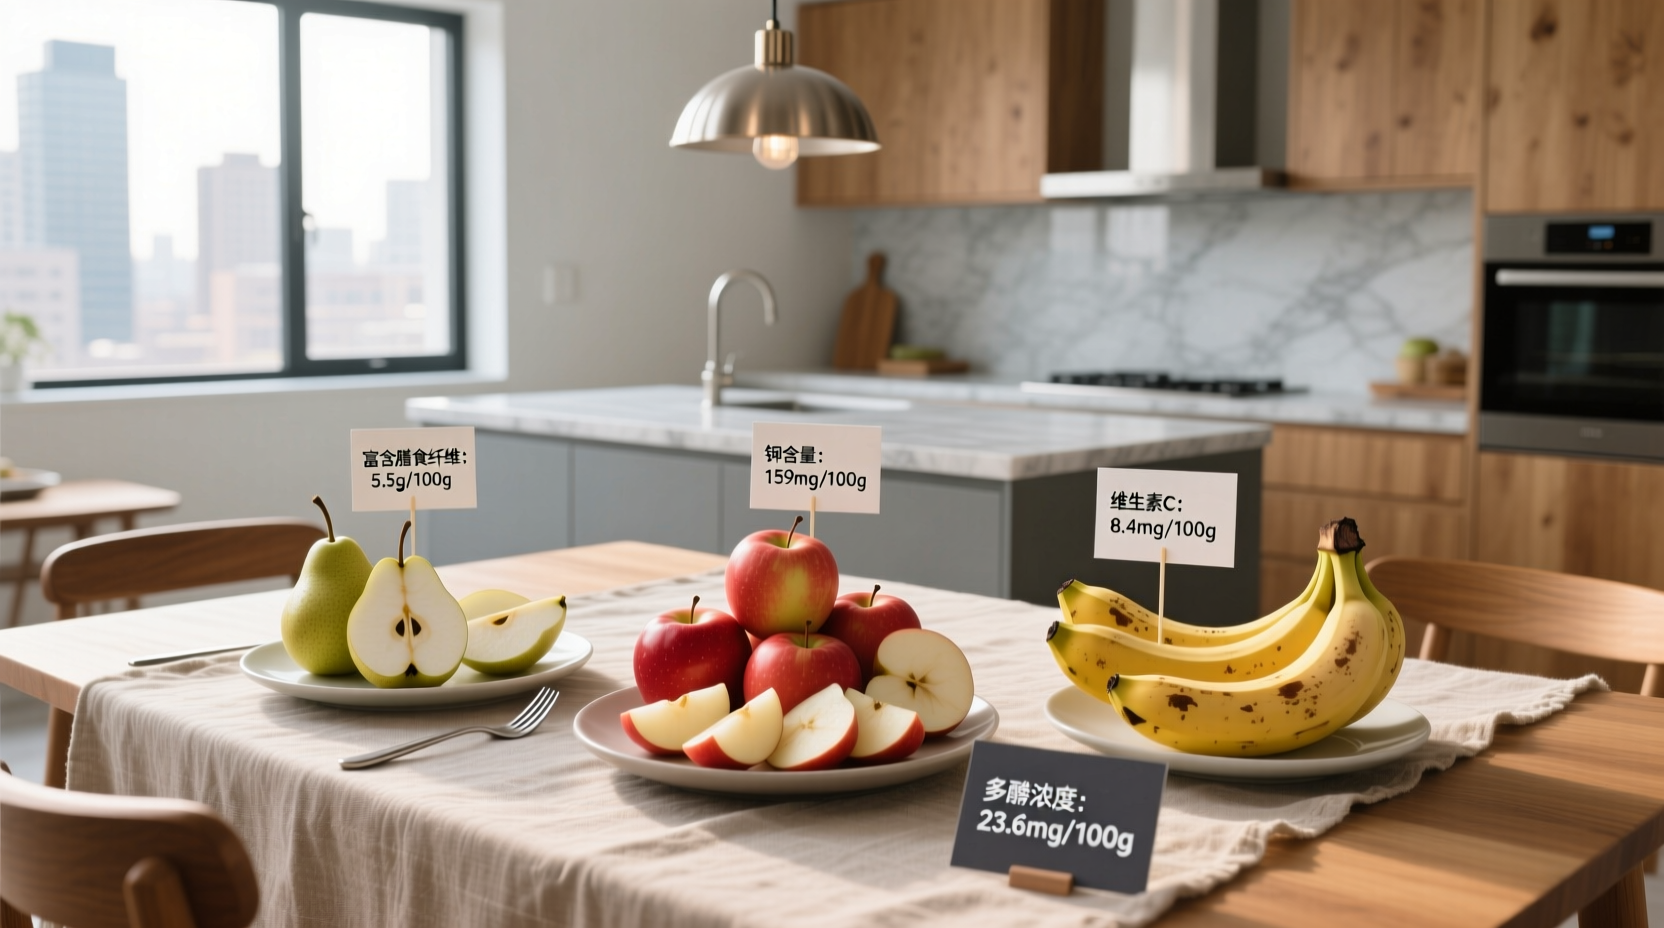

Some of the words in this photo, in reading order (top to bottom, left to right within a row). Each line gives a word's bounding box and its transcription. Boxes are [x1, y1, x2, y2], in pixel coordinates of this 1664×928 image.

[371, 471, 452, 492] 5.5g/100g
[765, 469, 867, 492] 159mg/100g
[1110, 517, 1217, 543] 8.4mg/100g
[976, 808, 1136, 858] 23.6mg/100g
